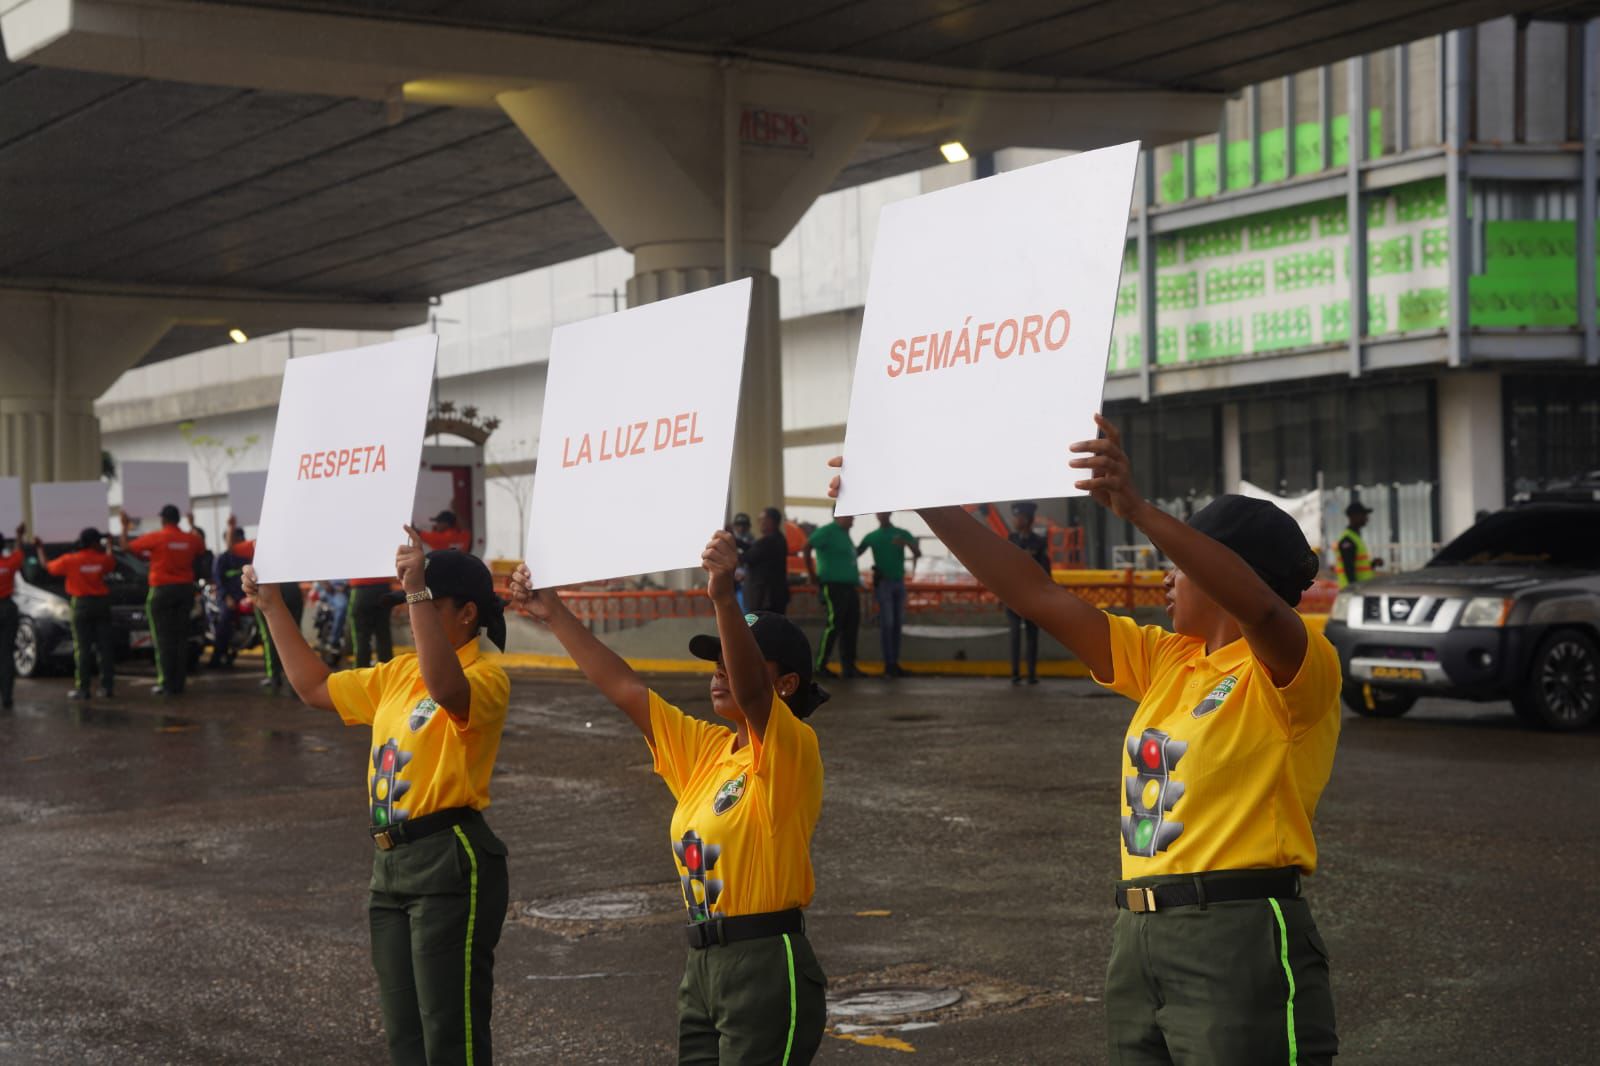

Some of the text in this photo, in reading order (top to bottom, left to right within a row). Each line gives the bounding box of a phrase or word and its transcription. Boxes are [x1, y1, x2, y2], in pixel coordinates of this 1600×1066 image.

[887, 309, 1071, 378] SEMÁFORO
[297, 444, 386, 481] RESPETA
[562, 411, 704, 468] LA LUZ DEL
